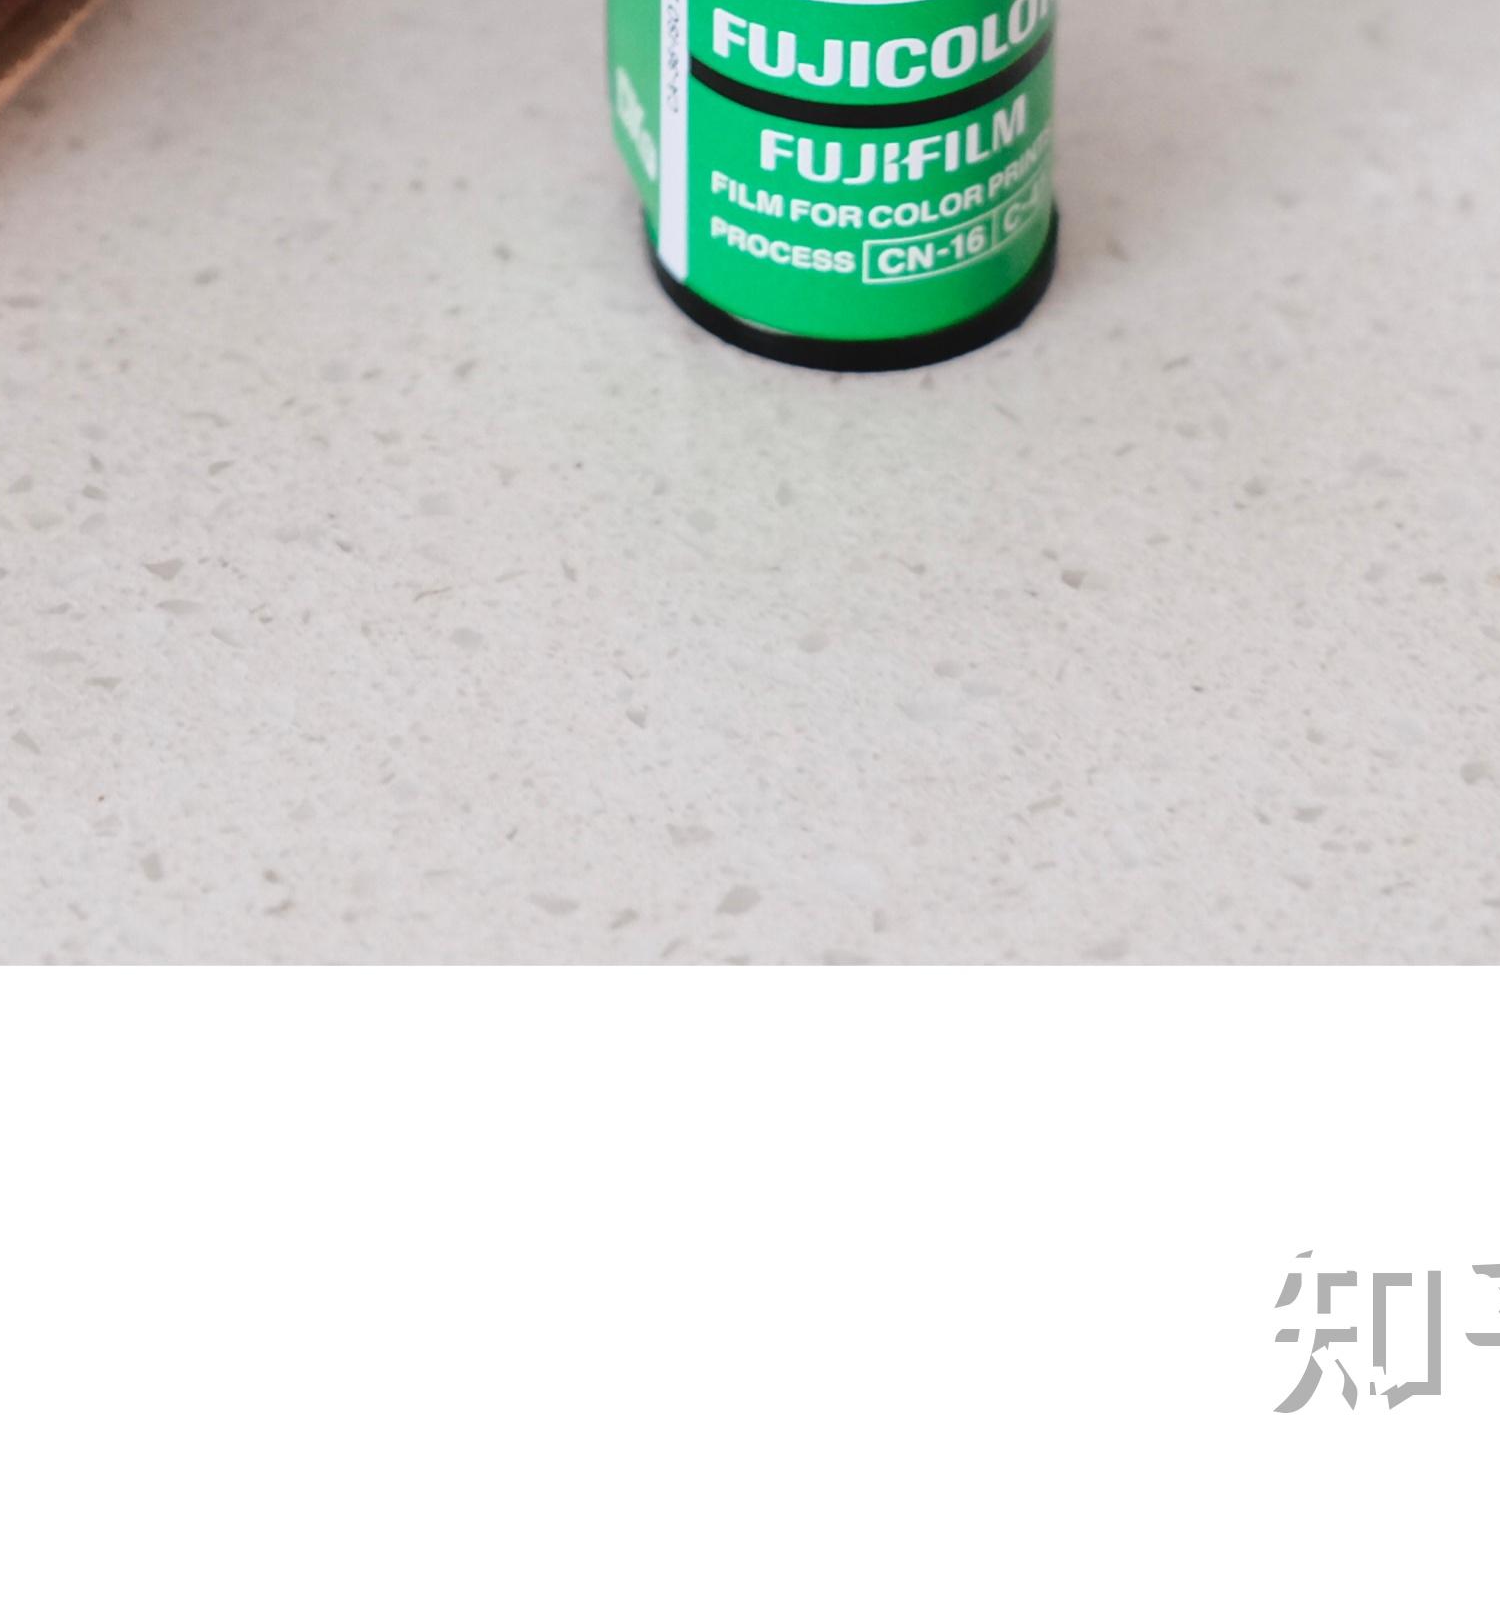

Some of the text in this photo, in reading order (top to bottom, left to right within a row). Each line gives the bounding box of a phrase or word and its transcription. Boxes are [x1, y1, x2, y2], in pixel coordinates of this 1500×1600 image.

[760, 94, 1027, 186] FUJIFILM
[710, 169, 784, 218] FILM
[790, 198, 864, 229] FOR
[868, 183, 985, 230] COLOR
[709, 215, 857, 274] PROCESS
[876, 224, 986, 276] CN-16
